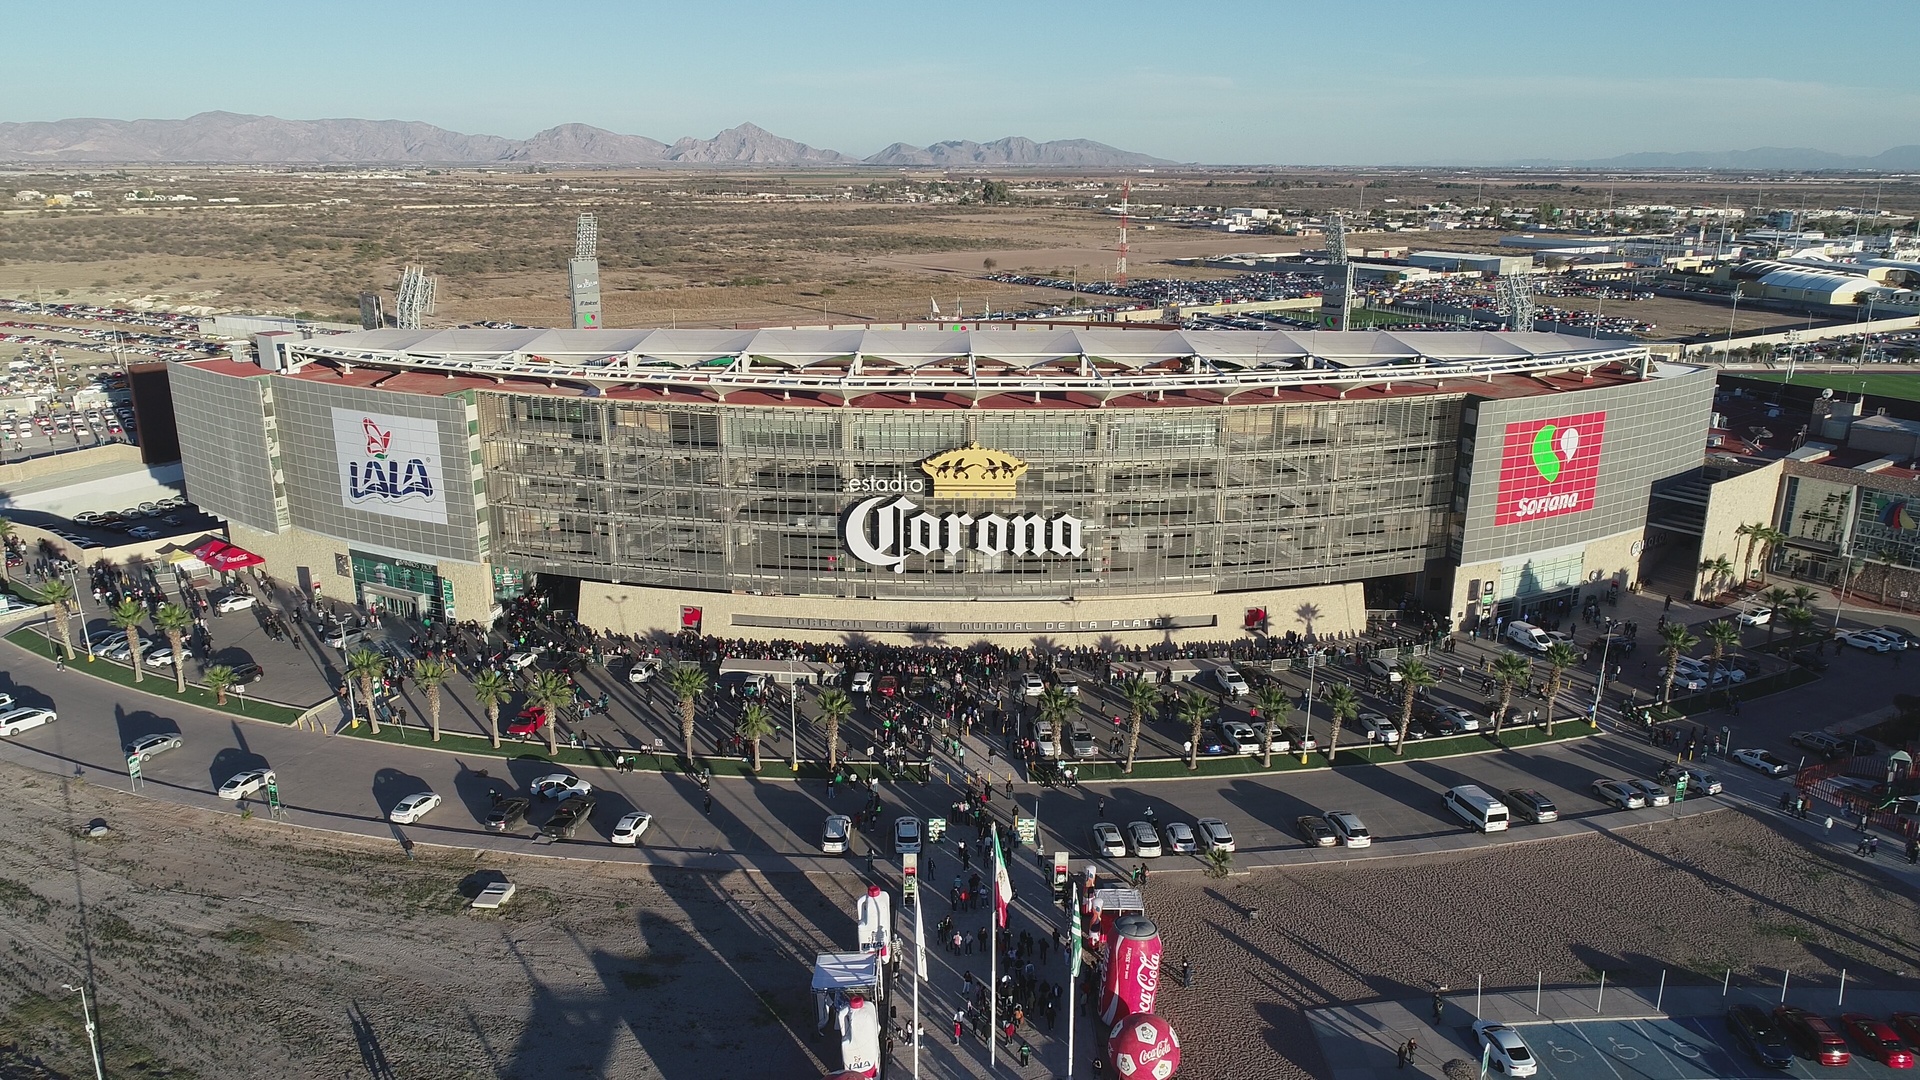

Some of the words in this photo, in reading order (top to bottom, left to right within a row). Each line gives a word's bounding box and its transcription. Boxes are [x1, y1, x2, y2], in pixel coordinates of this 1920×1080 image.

[349, 458, 434, 500] LALA
[849, 471, 923, 493] estadio
[1516, 492, 1579, 517] Soriana
[845, 495, 1087, 574] Corona
[959, 621, 1032, 631] MUNDIAL
[1045, 621, 1066, 630] DE
[1079, 620, 1098, 629] LA
[1110, 618, 1163, 628] PLATA
[1139, 1037, 1171, 1065] Coca-Cola
